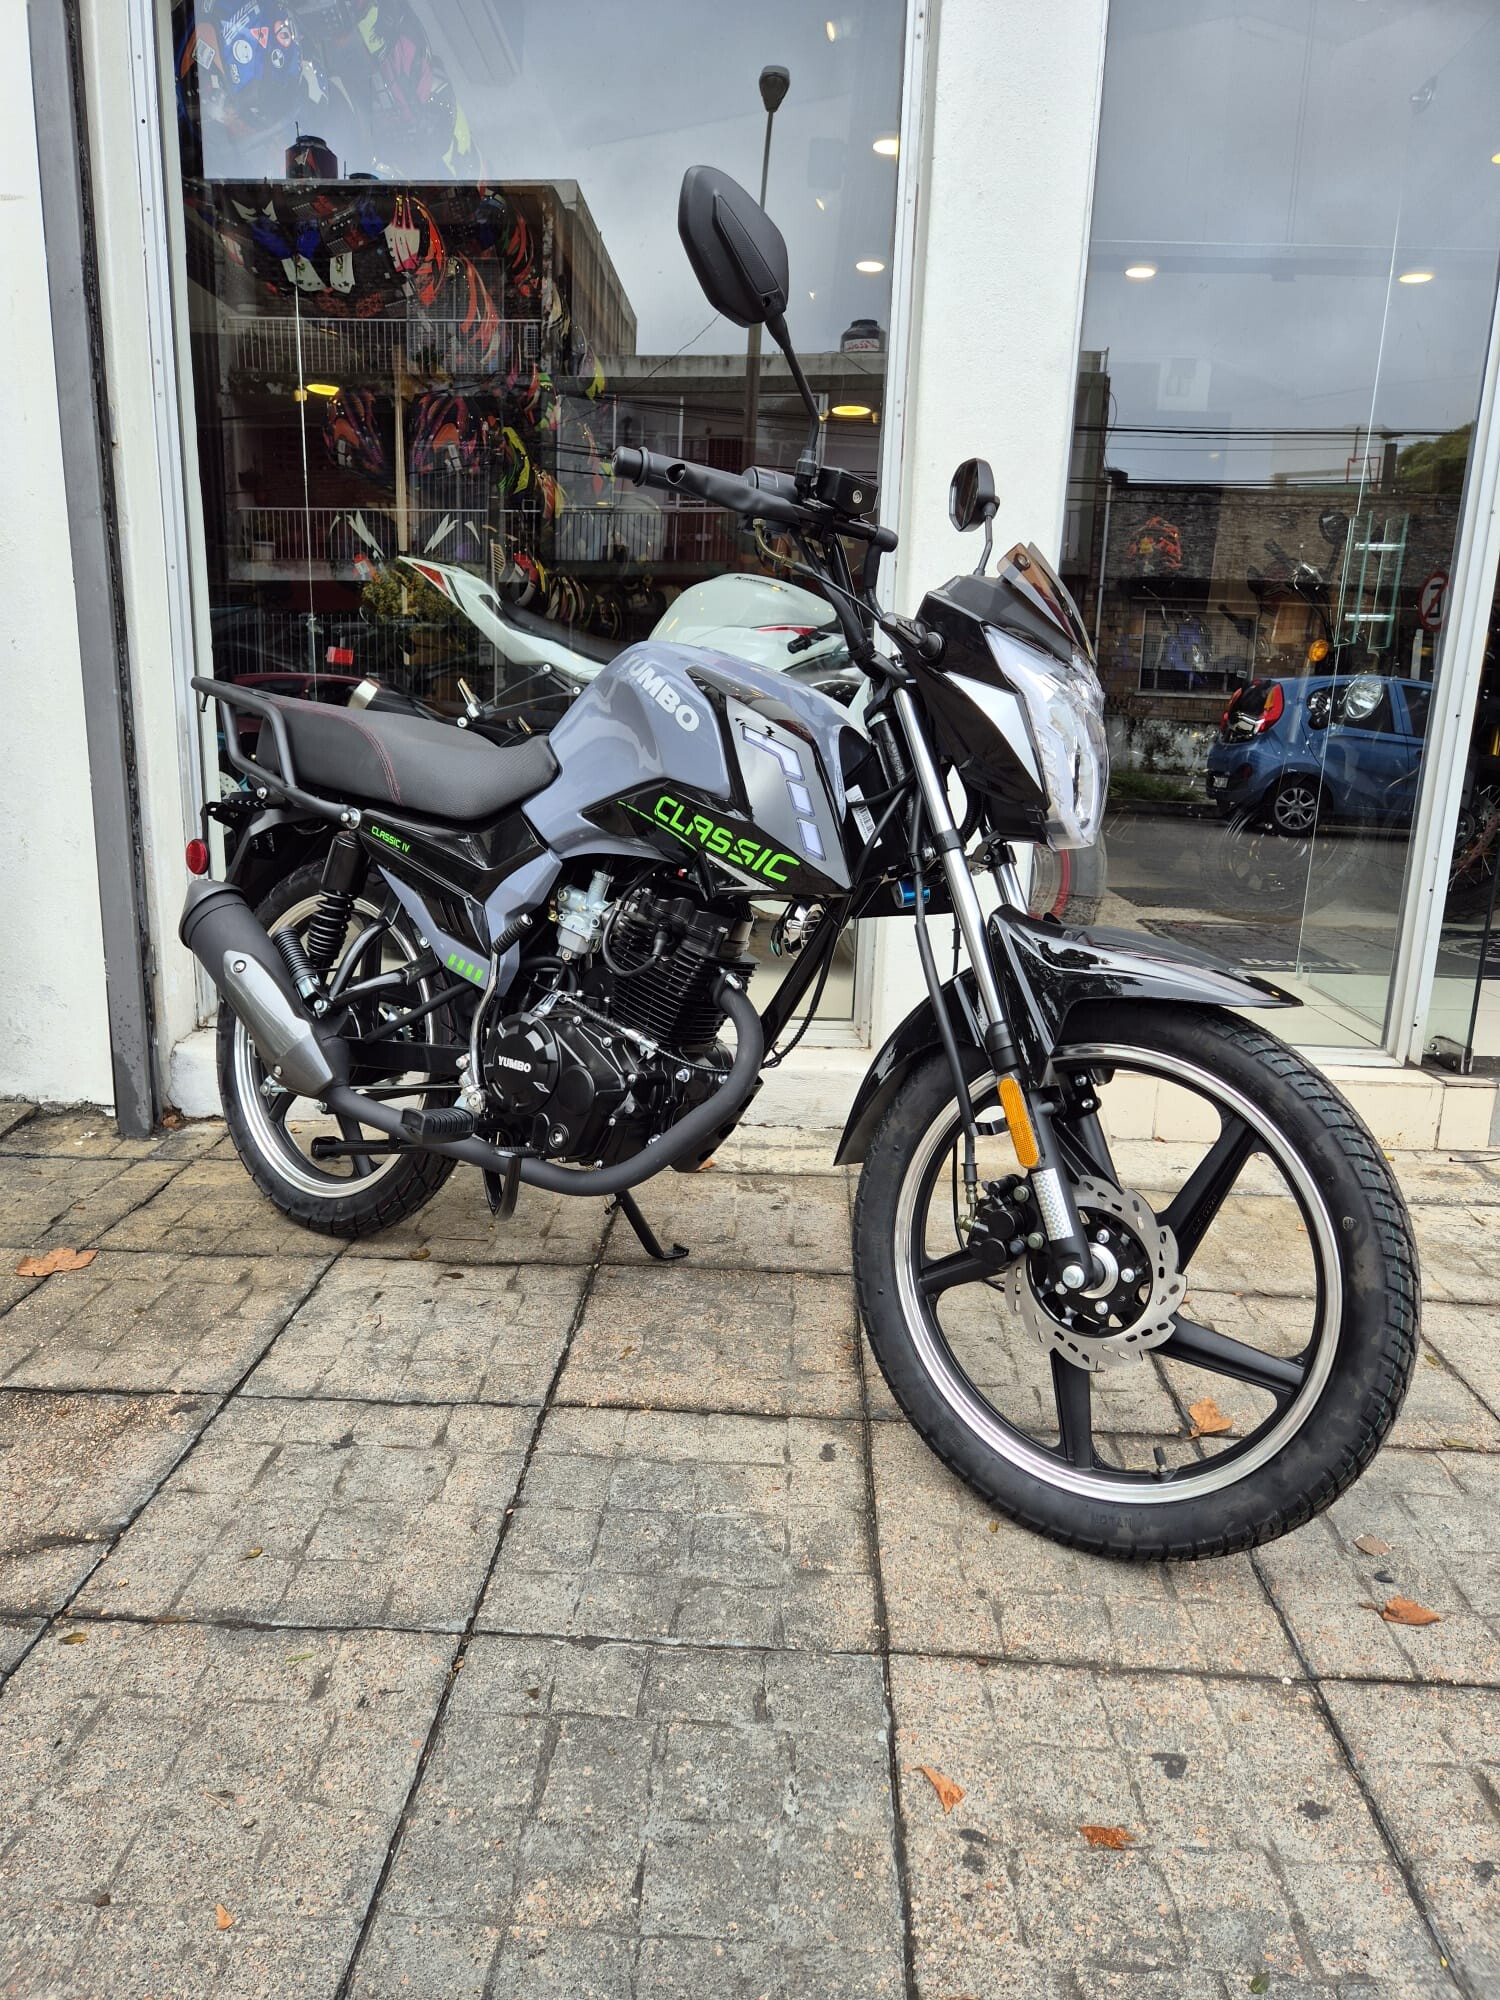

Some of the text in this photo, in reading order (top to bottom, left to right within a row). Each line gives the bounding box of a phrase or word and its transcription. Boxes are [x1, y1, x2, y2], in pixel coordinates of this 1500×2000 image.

[371, 825, 410, 853] CLASSIC IV
[655, 796, 800, 883] CLASSIC
[498, 1055, 531, 1073] YUMBO
